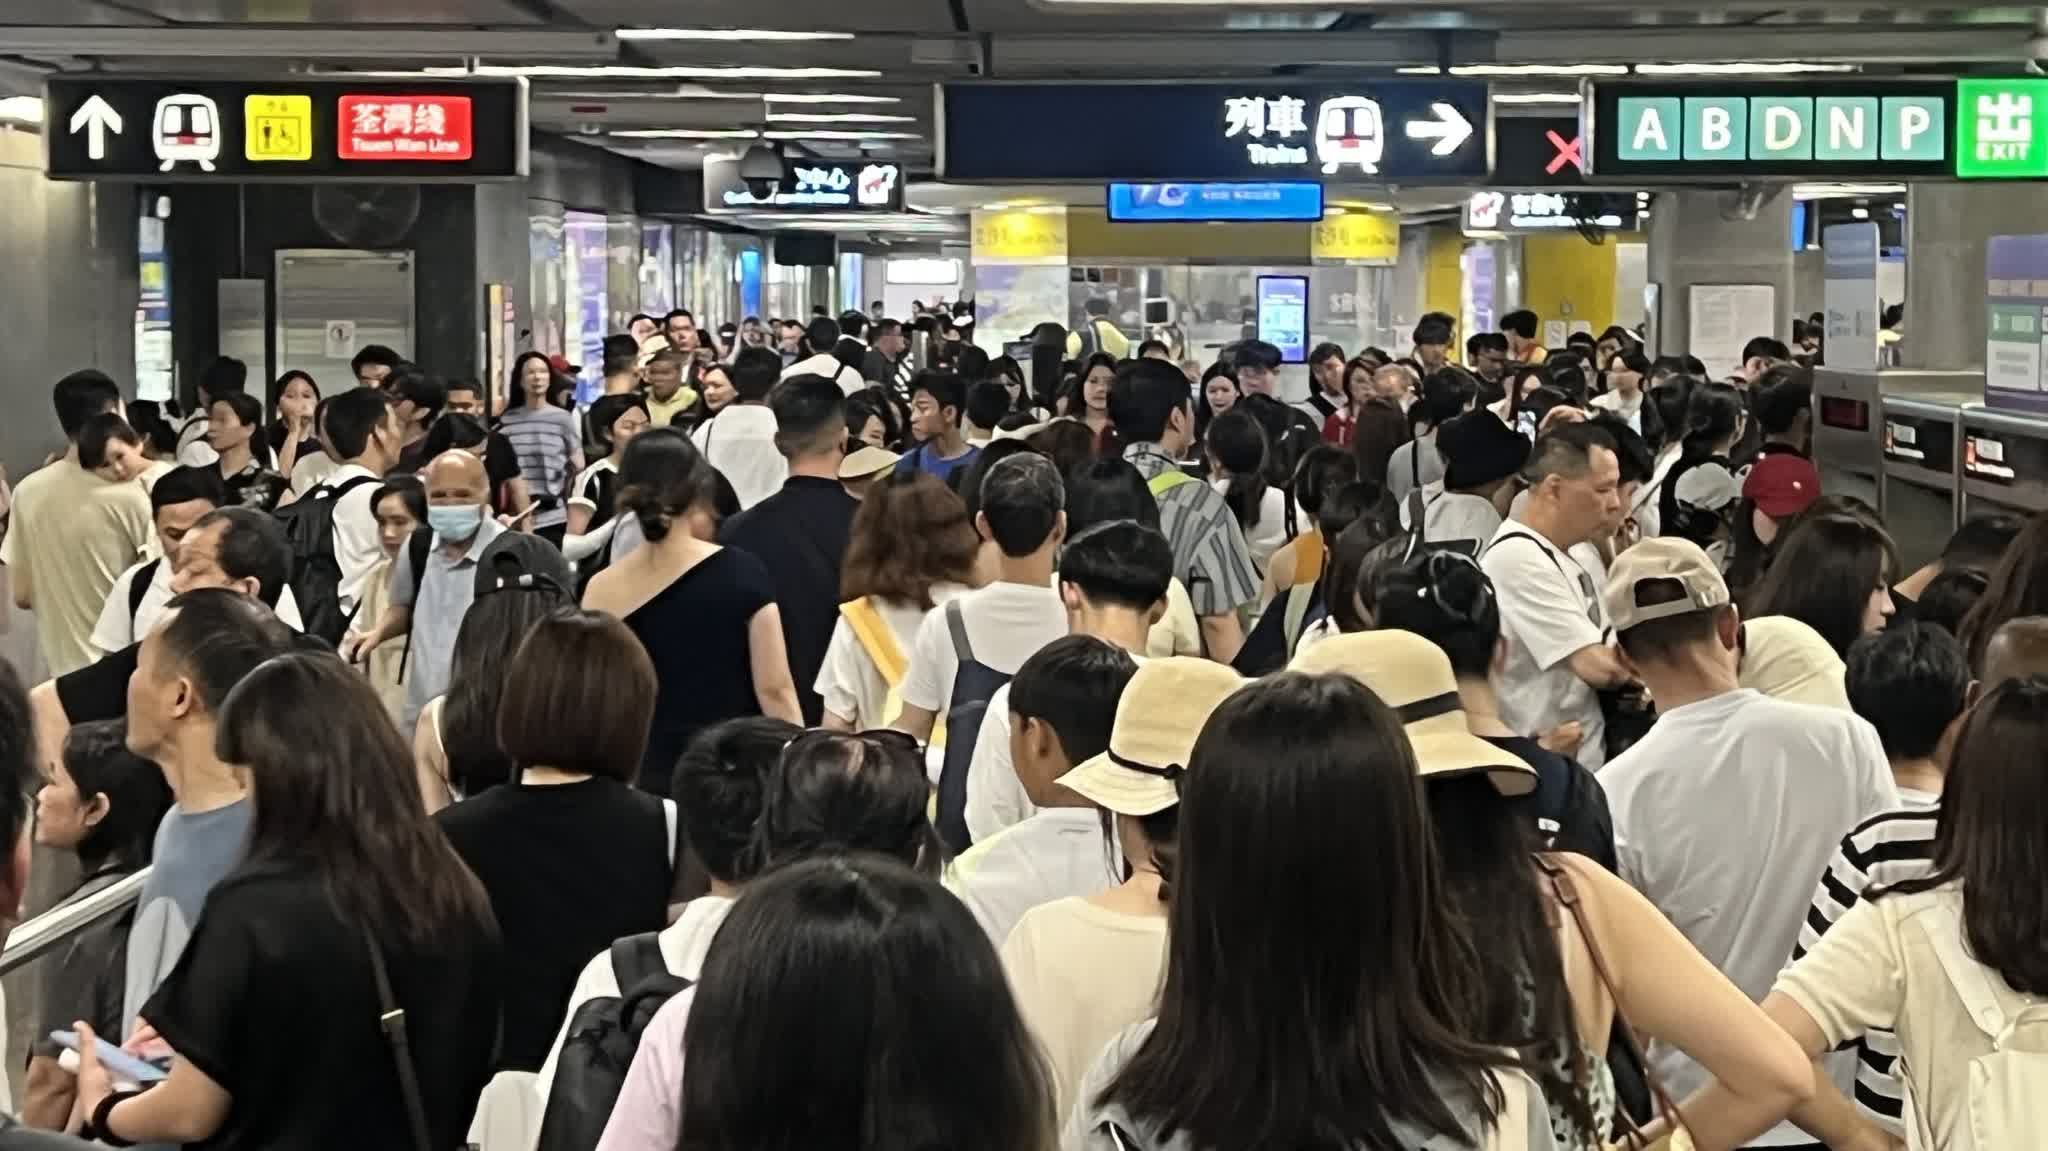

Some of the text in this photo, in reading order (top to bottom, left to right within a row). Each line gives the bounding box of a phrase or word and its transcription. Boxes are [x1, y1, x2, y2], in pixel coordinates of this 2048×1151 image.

[1224, 95, 1308, 137] 列車
[1631, 105, 1931, 150] A B D N P
[351, 137, 460, 153] Tsuen Wan Line
[1247, 143, 1308, 164] Trains
[1976, 143, 2030, 160] EXIT
